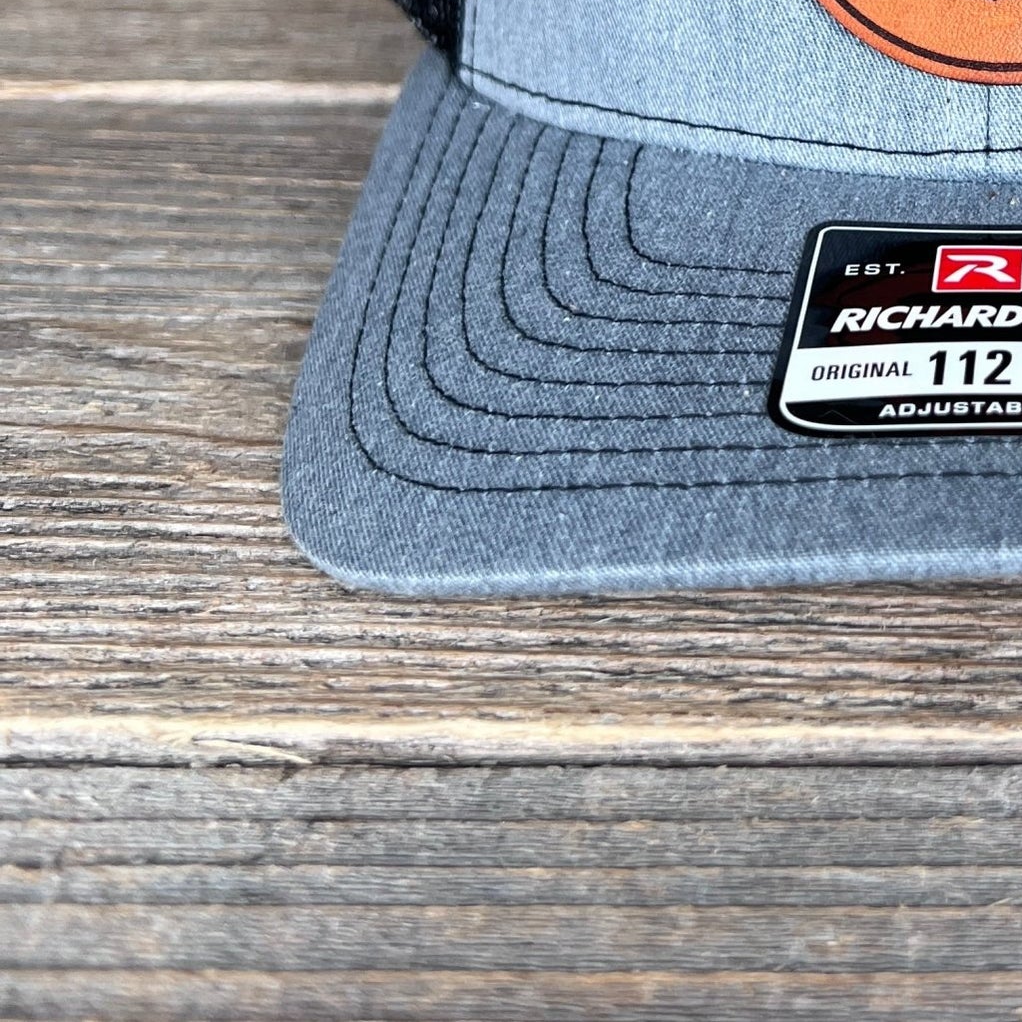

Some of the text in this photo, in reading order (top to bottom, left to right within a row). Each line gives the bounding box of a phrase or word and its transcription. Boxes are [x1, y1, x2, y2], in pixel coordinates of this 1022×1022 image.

[844, 262, 906, 277] EST.
[811, 360, 914, 381] ORIGINAL
[928, 349, 1013, 386] 112
